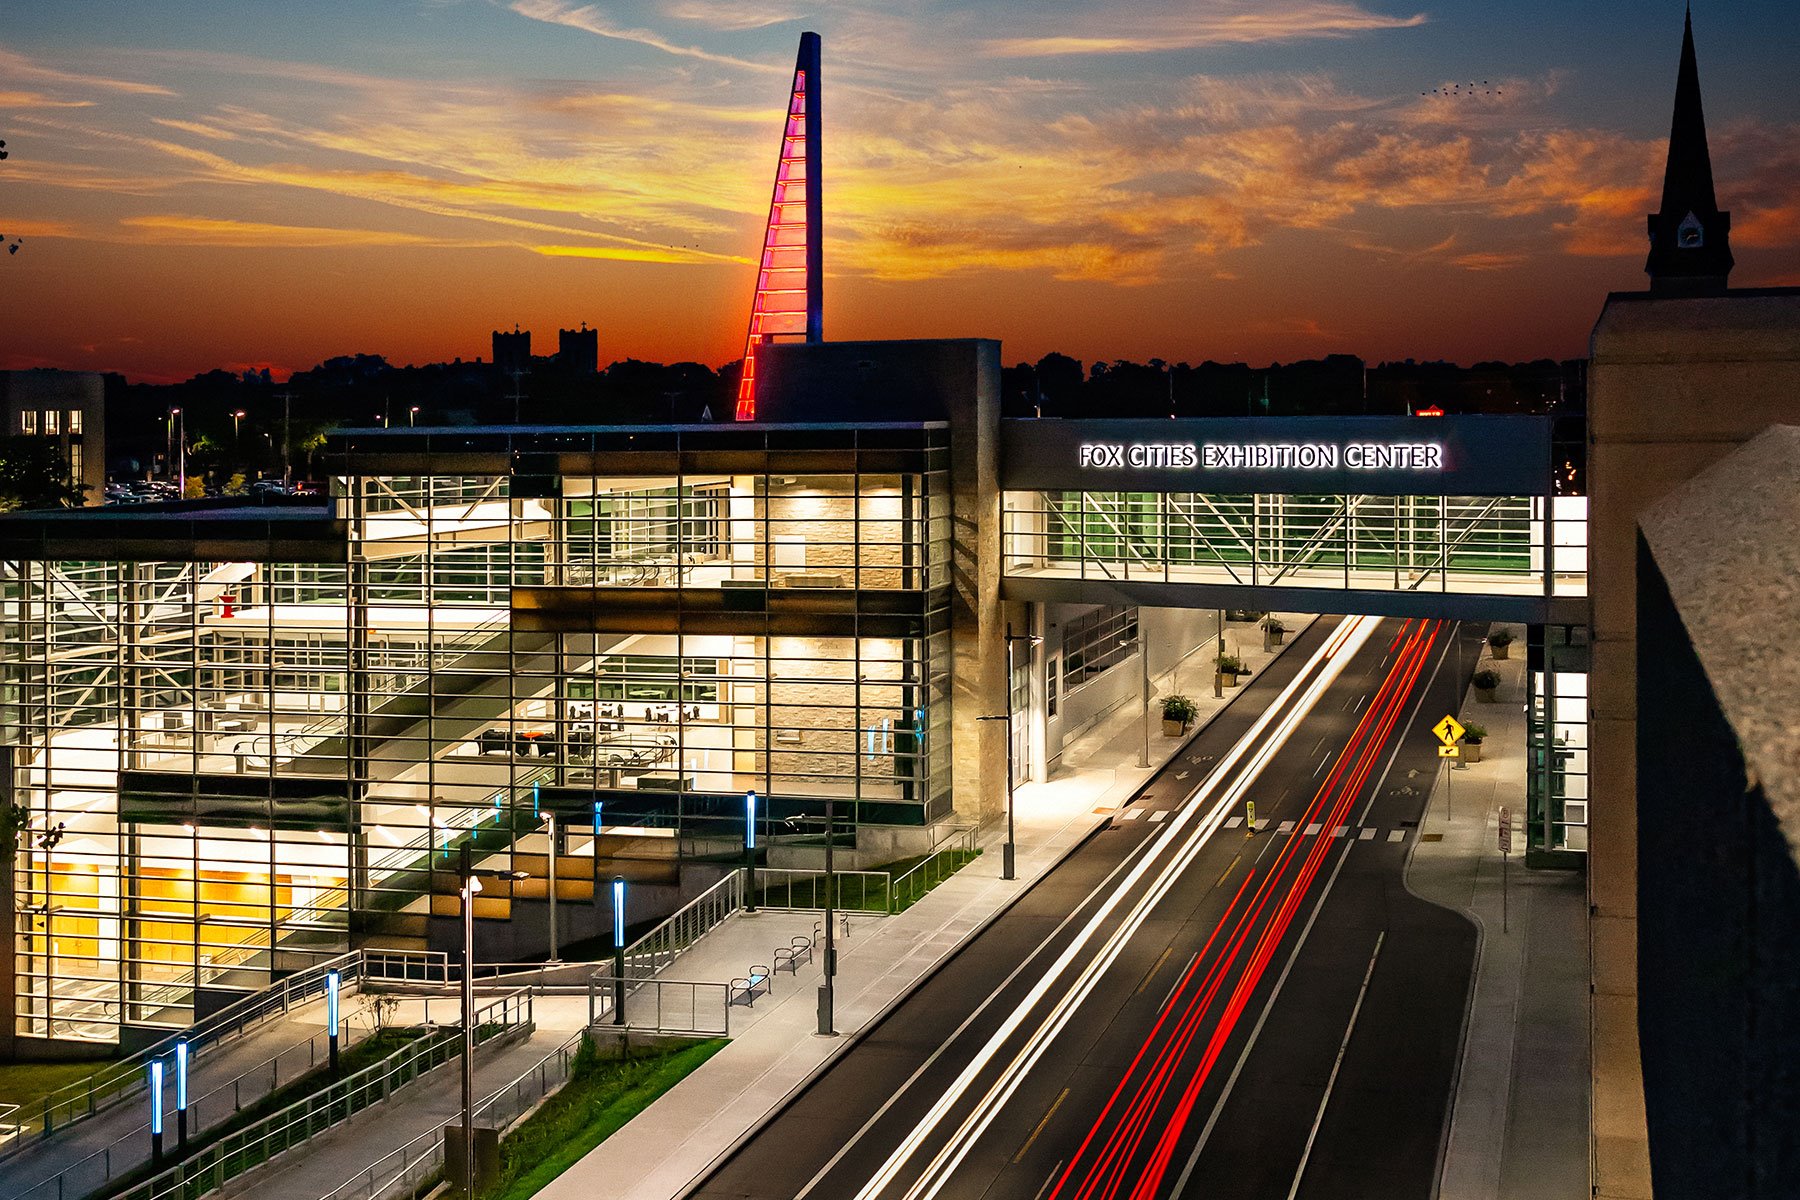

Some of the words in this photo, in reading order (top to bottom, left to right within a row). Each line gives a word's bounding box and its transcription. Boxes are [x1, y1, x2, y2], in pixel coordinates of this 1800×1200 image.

[1080, 446, 1123, 467] FOX
[1128, 445, 1197, 467] CITIES
[1203, 445, 1338, 468] EXHIBITION
[1344, 445, 1442, 469] CENTER
